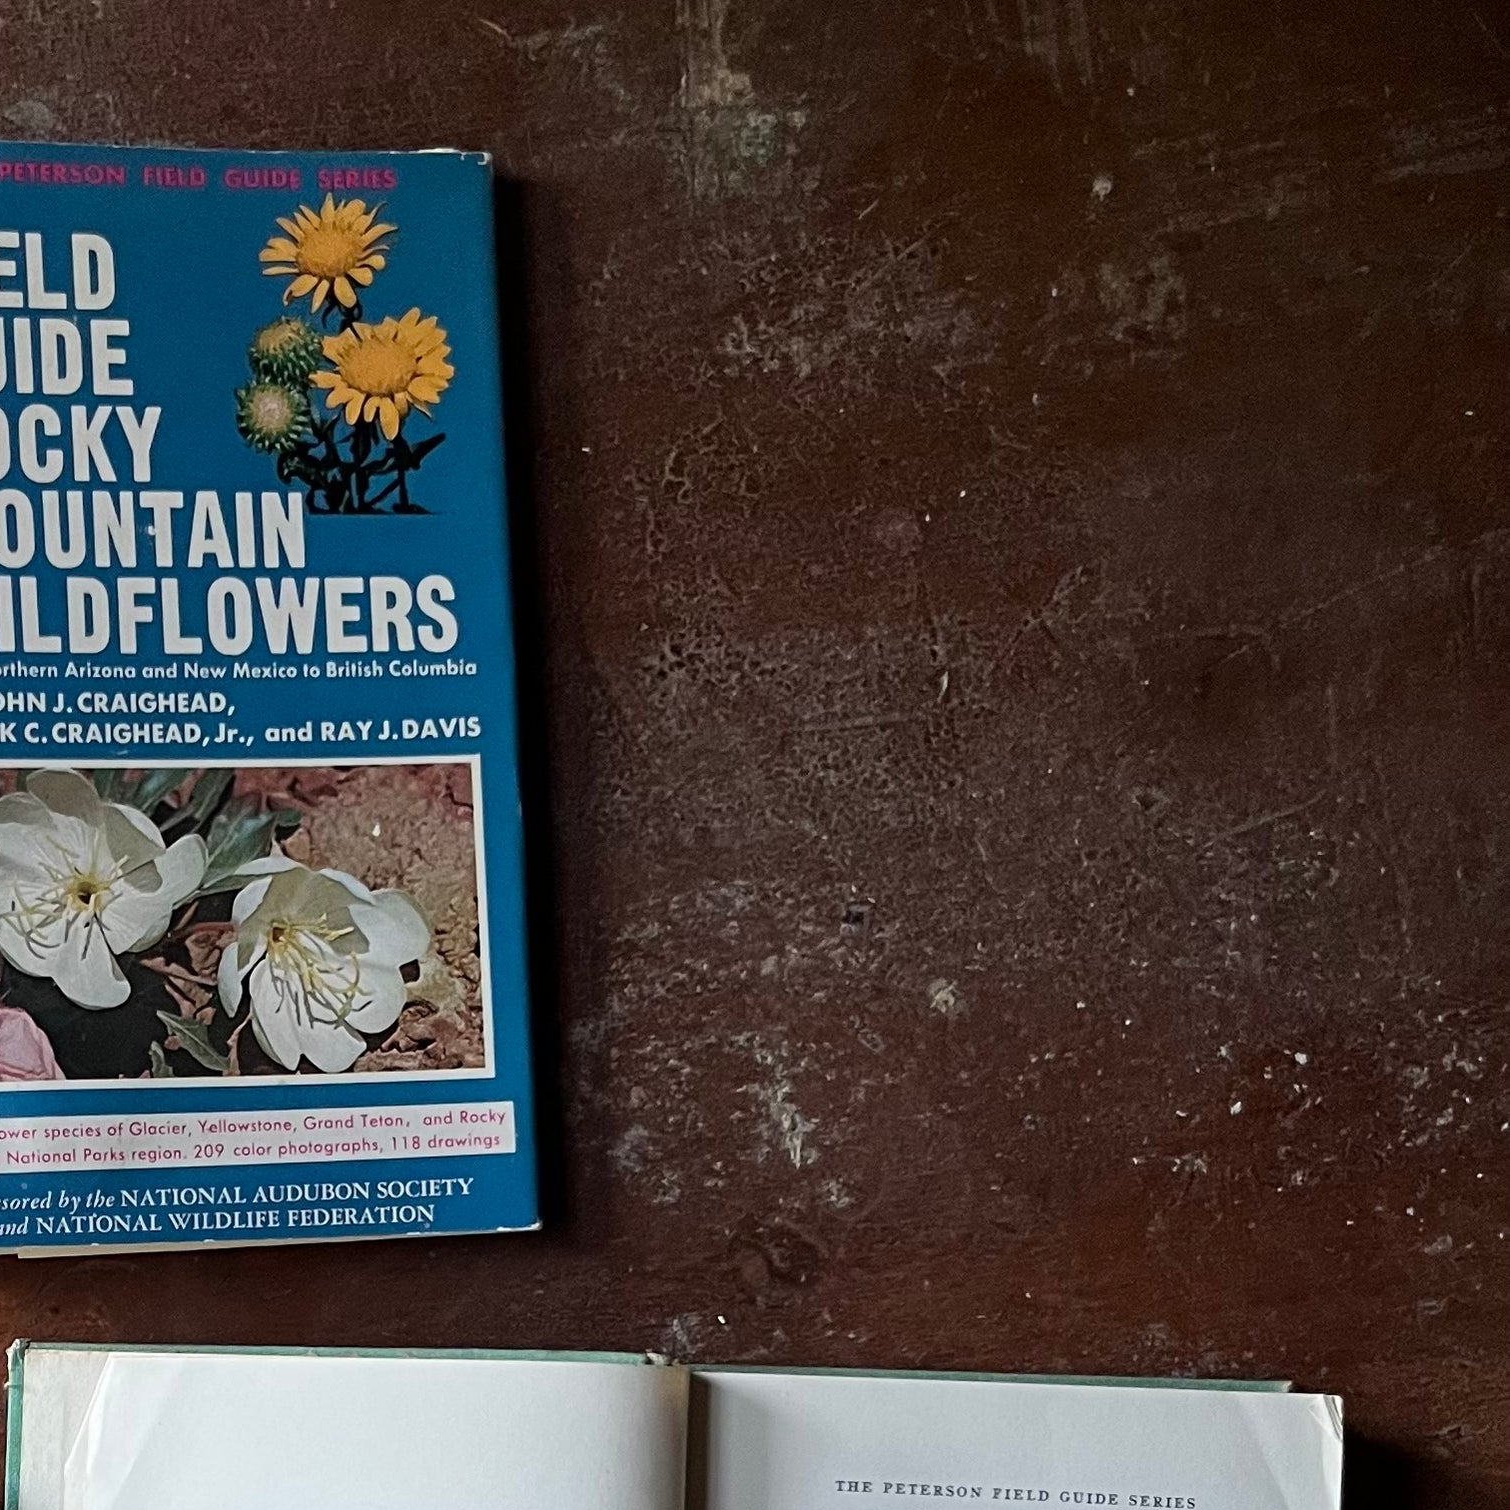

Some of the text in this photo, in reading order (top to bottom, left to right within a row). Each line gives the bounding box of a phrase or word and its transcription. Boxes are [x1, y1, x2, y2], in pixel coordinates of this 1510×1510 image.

[52, 692, 73, 714] J.
[77, 691, 236, 716] CRAIGHEAD,
[44, 1123, 102, 1142] species
[106, 1122, 124, 1137] of
[128, 1120, 192, 1138] Glacier,
[197, 1119, 297, 1134] Yellowstone,
[303, 1114, 354, 1131] Grand
[359, 1113, 411, 1128] Teton,
[422, 1110, 453, 1127] and
[459, 1109, 506, 1125] Rocky
[58, 1189, 82, 1215] by
[85, 1189, 116, 1209] the
[120, 1186, 247, 1208] NATIONAL
[252, 1181, 370, 1203] AUDUBON
[376, 1177, 474, 1199] SOCIETY
[35, 1212, 163, 1234] NATIONAL
[168, 1209, 280, 1230] WILDLIFE
[287, 1204, 435, 1227] FEDERATION
